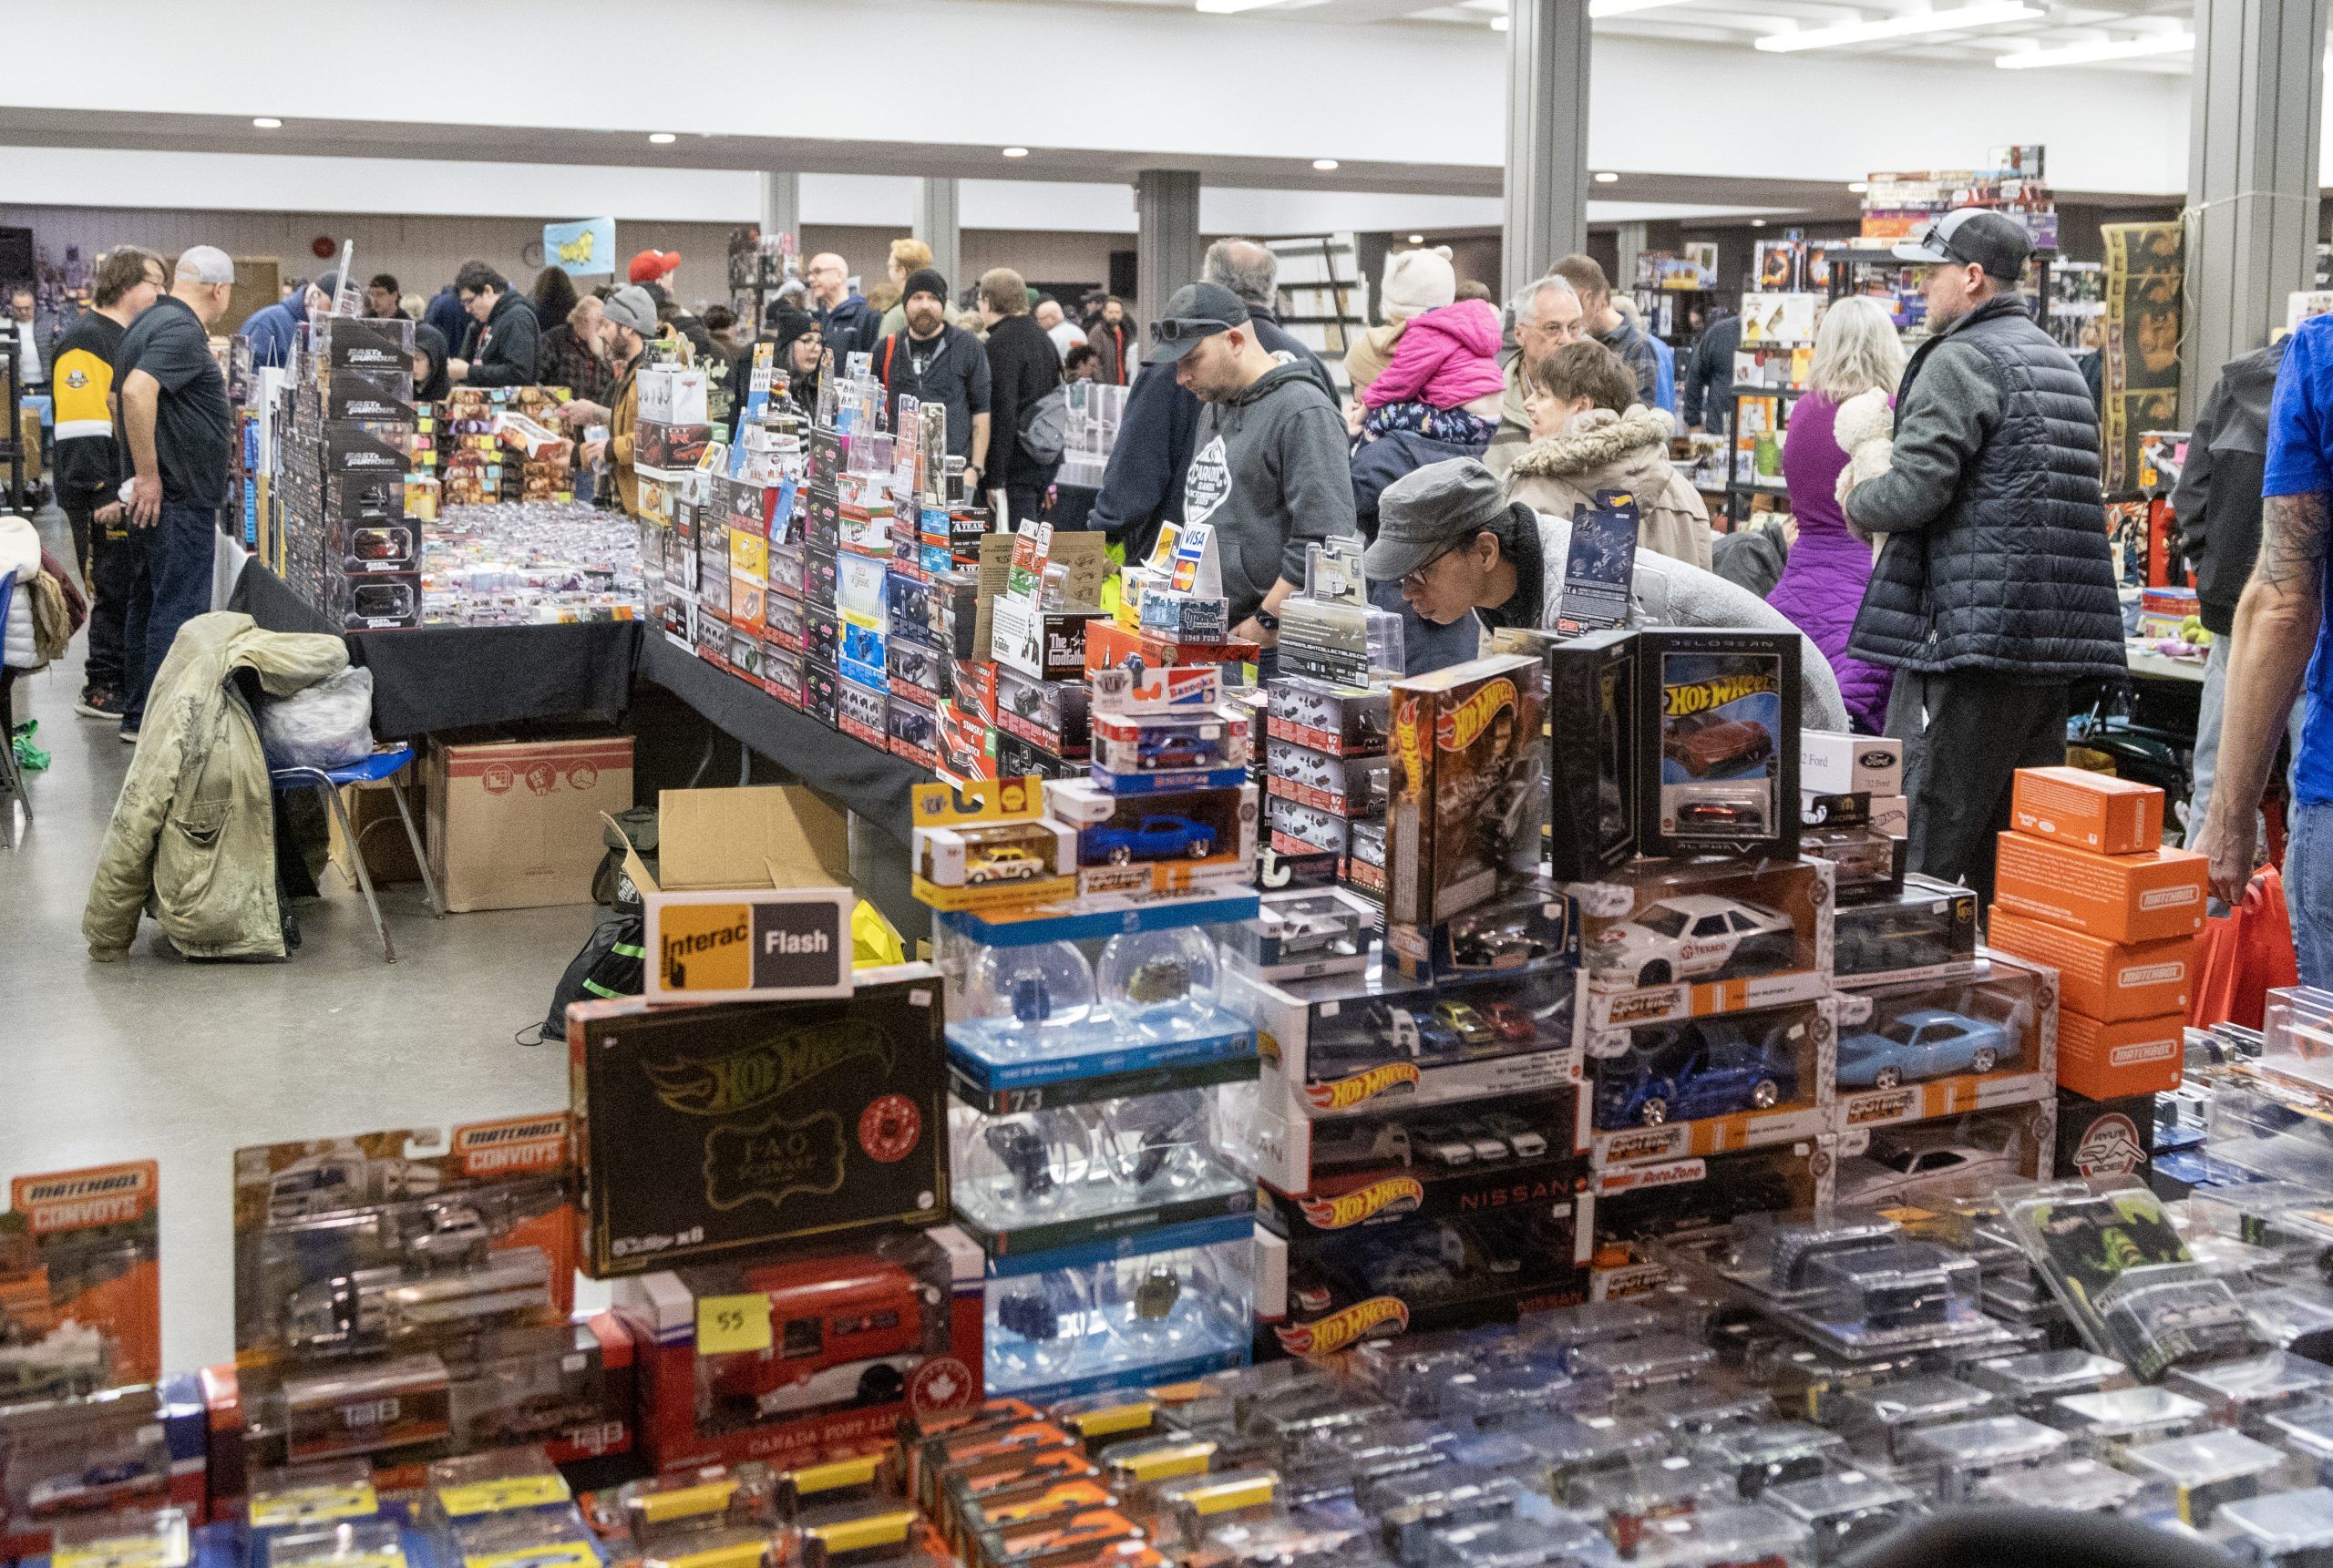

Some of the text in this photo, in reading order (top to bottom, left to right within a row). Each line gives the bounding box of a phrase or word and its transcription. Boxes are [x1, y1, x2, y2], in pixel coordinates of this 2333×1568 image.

[1186, 529, 1205, 546] VISA
[1049, 633, 1067, 649] The
[1048, 648, 1085, 666] Godfath
[1667, 686, 1710, 715] HOT
[1809, 753, 1828, 767] Ford
[2143, 887, 2194, 907] MATCHBOX
[662, 923, 829, 957] Interac Flash
[1694, 943, 1727, 955] TEXACO
[2122, 966, 2179, 984] MATCHBOX
[2113, 1043, 2173, 1062] MATCHBOX
[1333, 1064, 1414, 1109] HOT WHEELS
[468, 1120, 566, 1145] MATCHBOX
[468, 1141, 560, 1169] CONVOYS
[2092, 1162, 2124, 1173] RIDES
[30, 1172, 140, 1201] MATCHBOX
[1460, 1182, 1568, 1210] NISSAN
[33, 1199, 137, 1229] CONVOYS
[1332, 1178, 1417, 1226] HOT WHEELS
[1310, 1300, 1405, 1354] HOT WHEELS
[749, 1430, 817, 1453] CANADA
